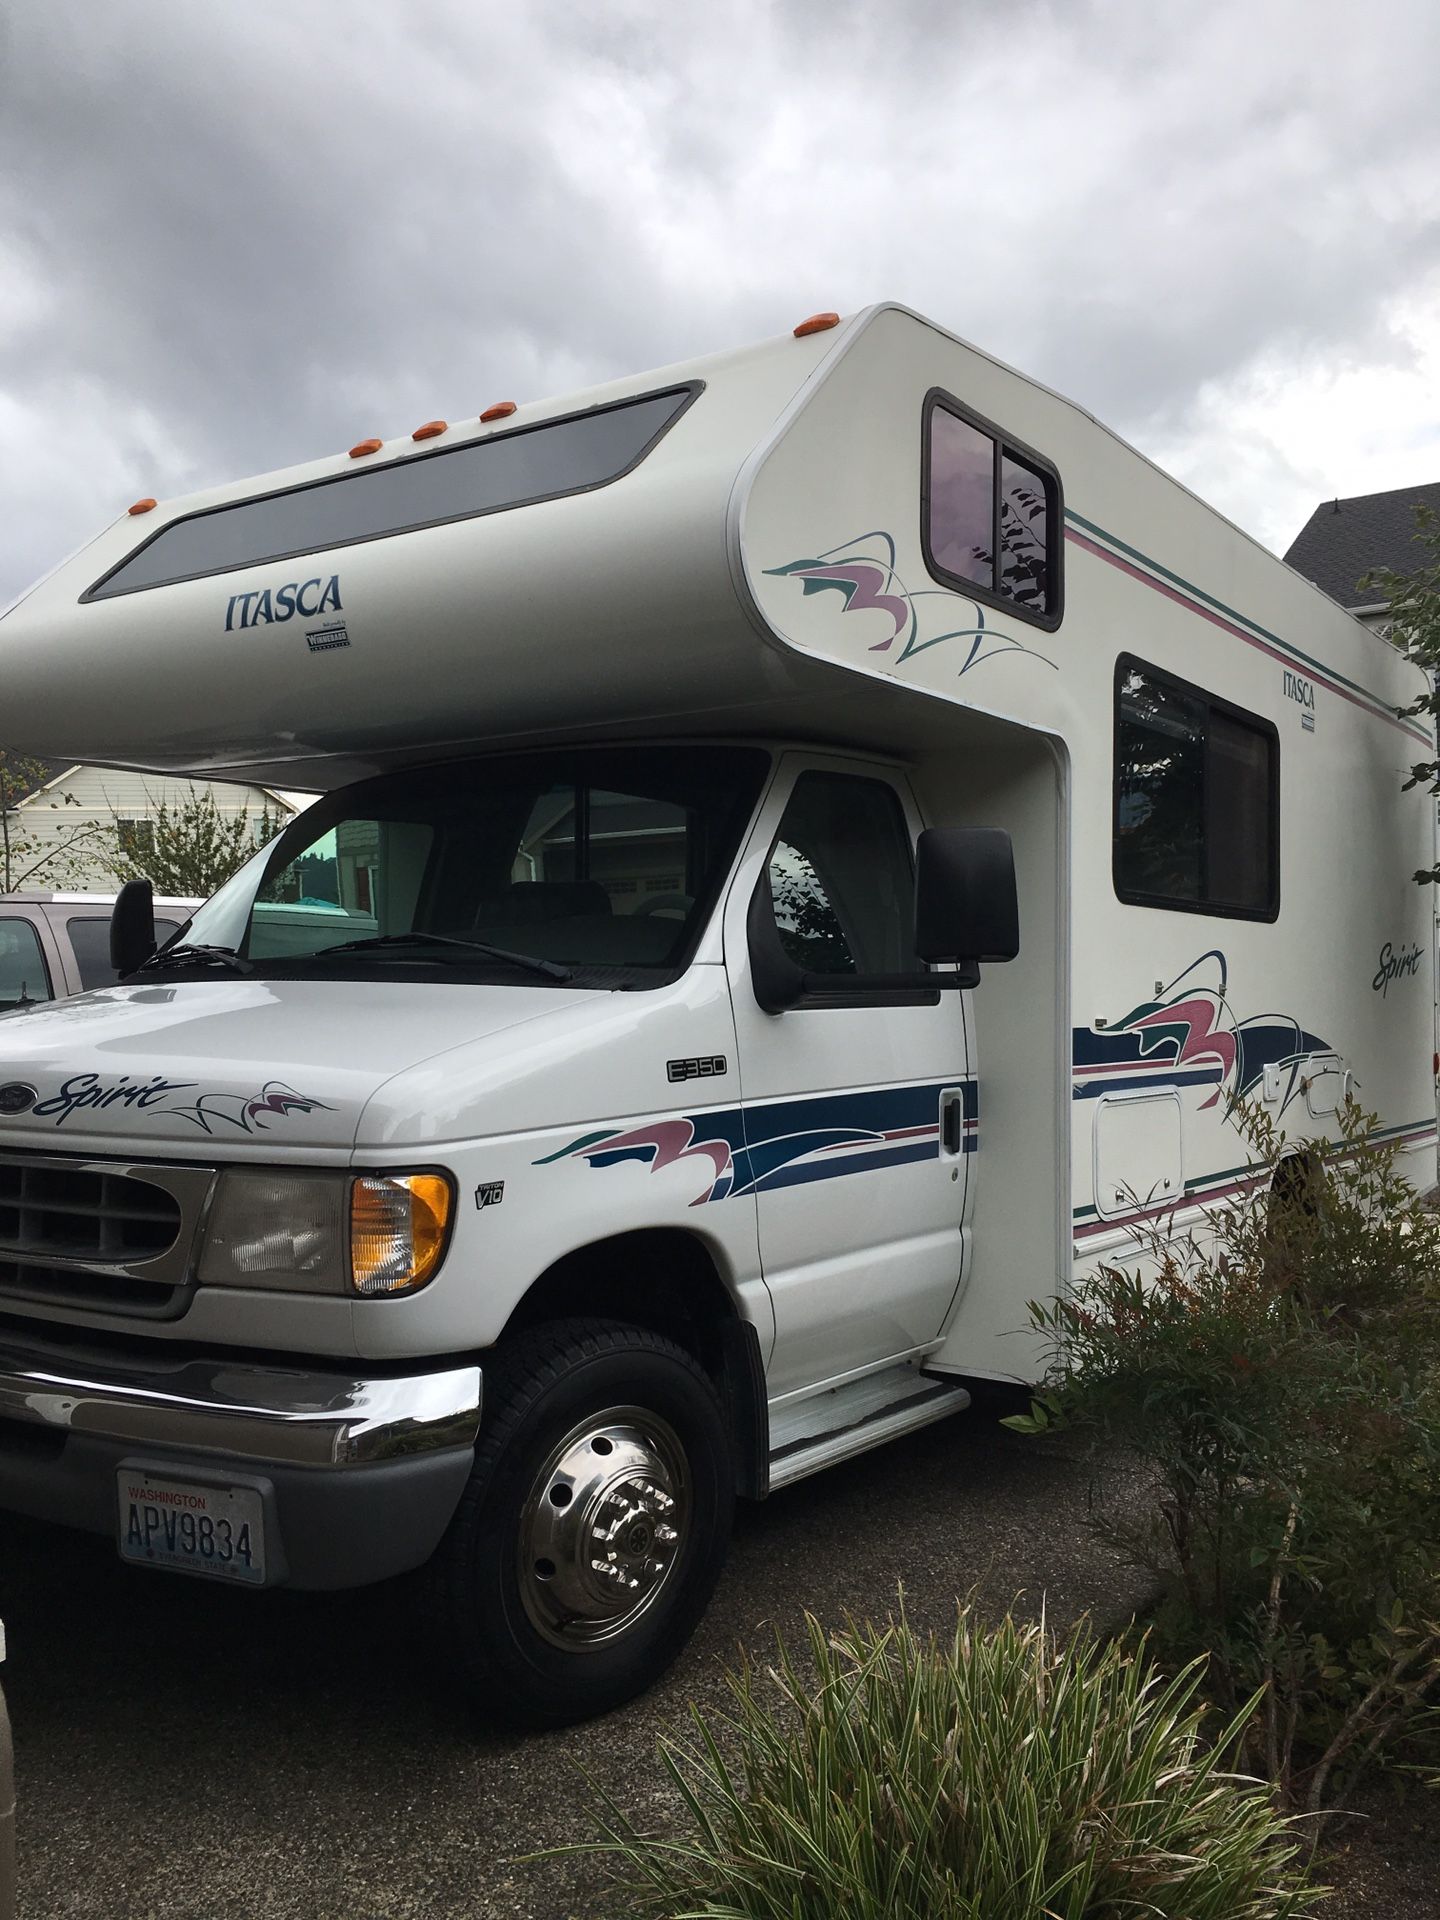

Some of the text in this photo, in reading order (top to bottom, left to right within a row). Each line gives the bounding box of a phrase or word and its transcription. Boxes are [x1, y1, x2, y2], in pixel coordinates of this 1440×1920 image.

[225, 575, 343, 632] ITASCA
[1283, 670, 1315, 710] ITASCA
[1372, 942, 1425, 999] Spirit
[32, 1073, 198, 1126] Spirit
[476, 1189, 502, 1209] V10
[128, 1486, 207, 1510] WASHINGTON
[128, 1503, 253, 1568] APV9834
